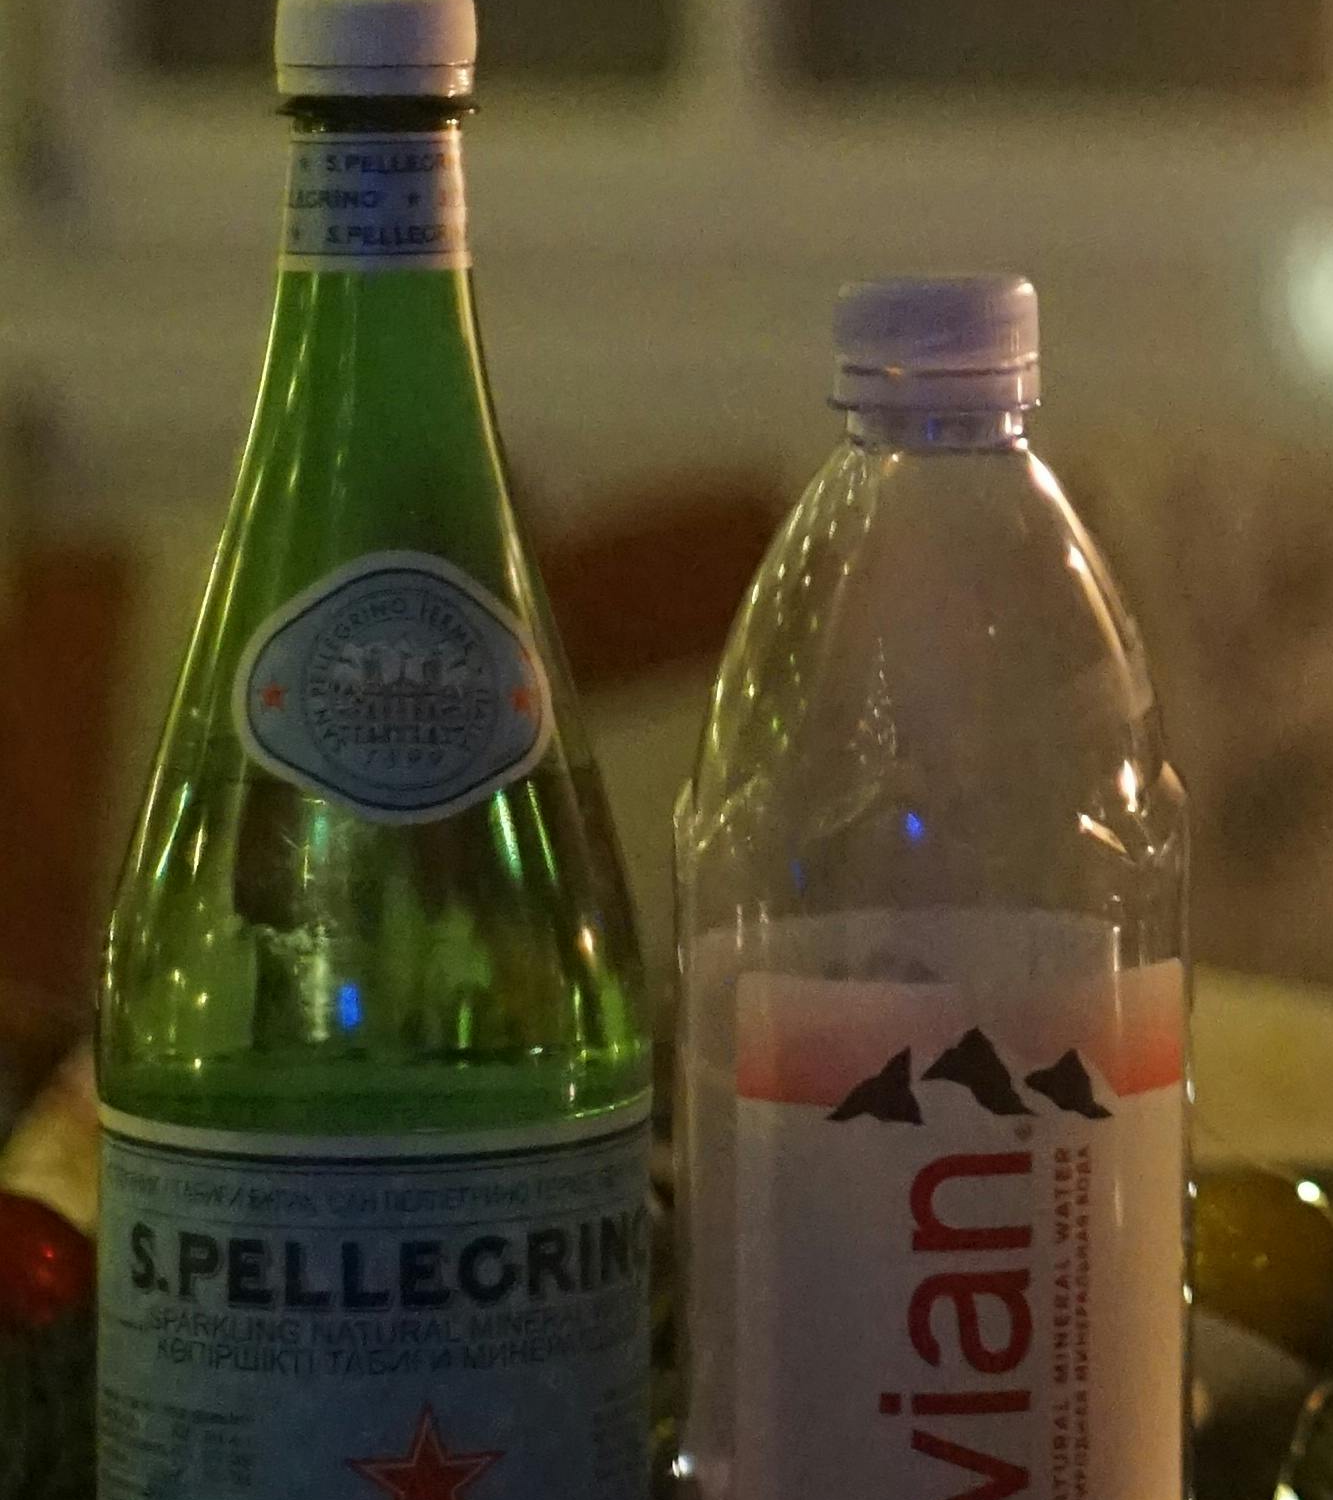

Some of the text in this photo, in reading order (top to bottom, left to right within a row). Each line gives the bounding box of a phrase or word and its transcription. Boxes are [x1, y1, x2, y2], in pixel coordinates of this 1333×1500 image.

[1051, 1146, 1072, 1246] WATER
[150, 1306, 302, 1345] SPARKLING
[311, 1317, 459, 1347] NATURAL
[1051, 1258, 1071, 1385] MINERAL
